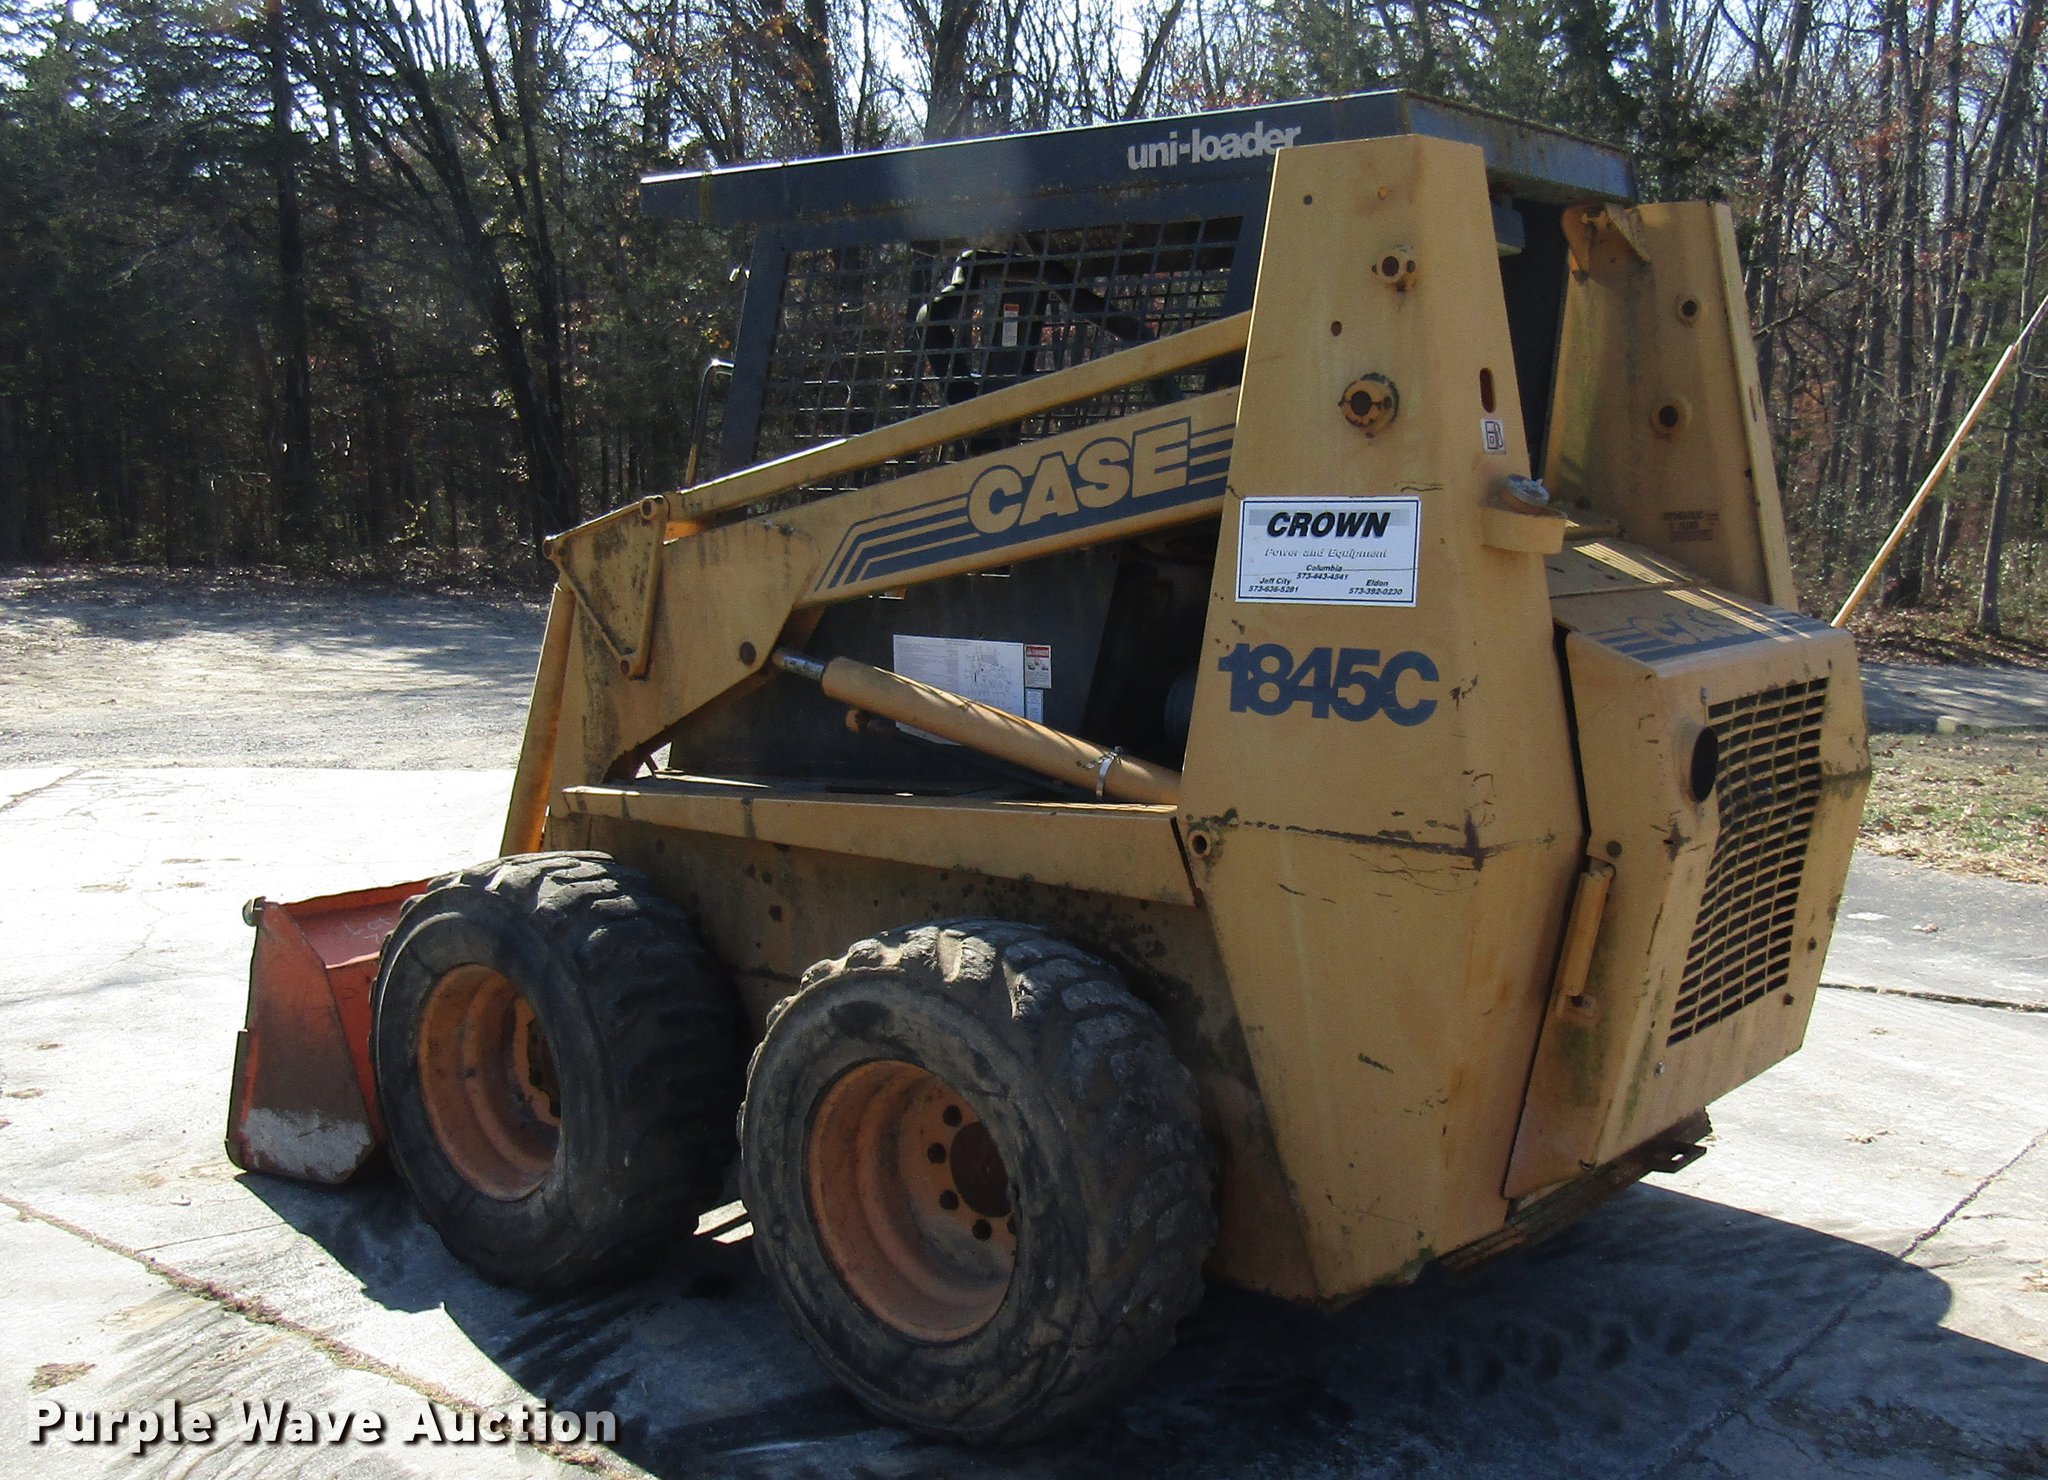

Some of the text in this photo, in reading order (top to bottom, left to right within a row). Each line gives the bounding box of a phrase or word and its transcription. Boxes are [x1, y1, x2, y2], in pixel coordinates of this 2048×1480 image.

[1127, 121, 1301, 170] uni-loader
[967, 416, 1191, 534] CASE
[1267, 512, 1391, 538] CROWN
[1264, 548, 1388, 560] Power and Equipment
[1306, 564, 1343, 572] Columbia
[1259, 577, 1292, 586] Jeff City
[1296, 572, 1349, 581] 573-443-4541
[1366, 579, 1389, 587] Eldon
[1218, 643, 1439, 727] 1845C
